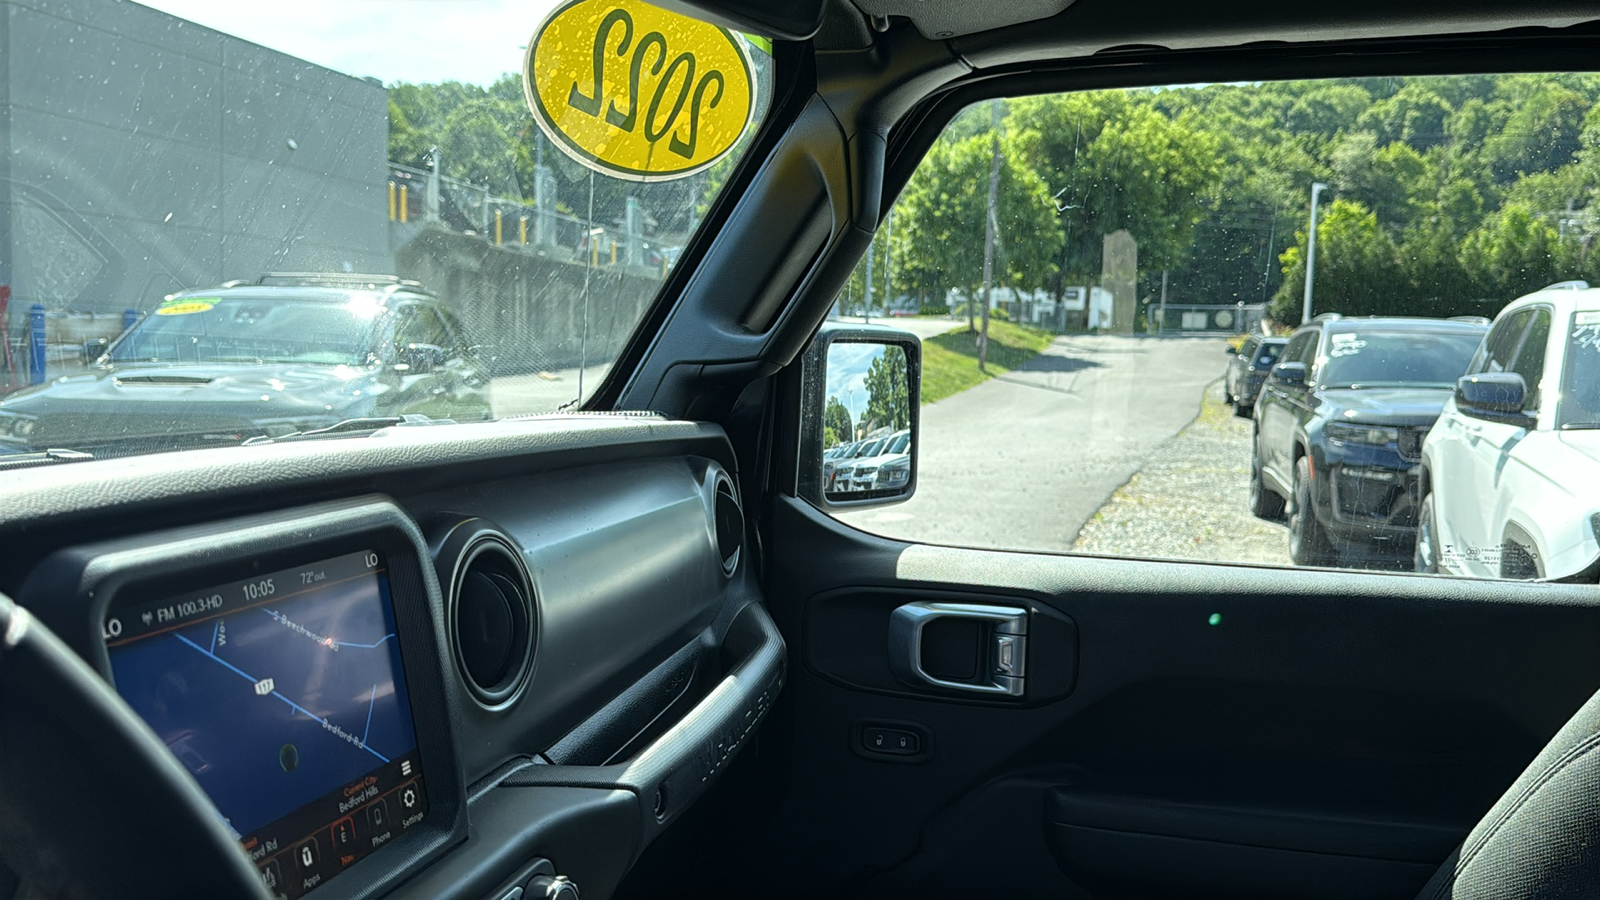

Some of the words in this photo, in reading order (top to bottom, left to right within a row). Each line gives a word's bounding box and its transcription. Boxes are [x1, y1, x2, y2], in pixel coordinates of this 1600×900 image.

[365, 553, 378, 568] LO
[242, 579, 275, 600] 10:05
[157, 607, 176, 622] FM
[177, 594, 223, 618] 100.3-HD
[281, 614, 327, 646] Beechwood
[322, 718, 352, 742] Bedford
[353, 736, 363, 749] Rd
[339, 791, 365, 813] Bedford
[365, 785, 379, 800] Hills
[402, 811, 424, 828] Settings
[266, 838, 278, 853] Rd
[372, 831, 391, 847] Phone
[303, 873, 321, 889] Apps
